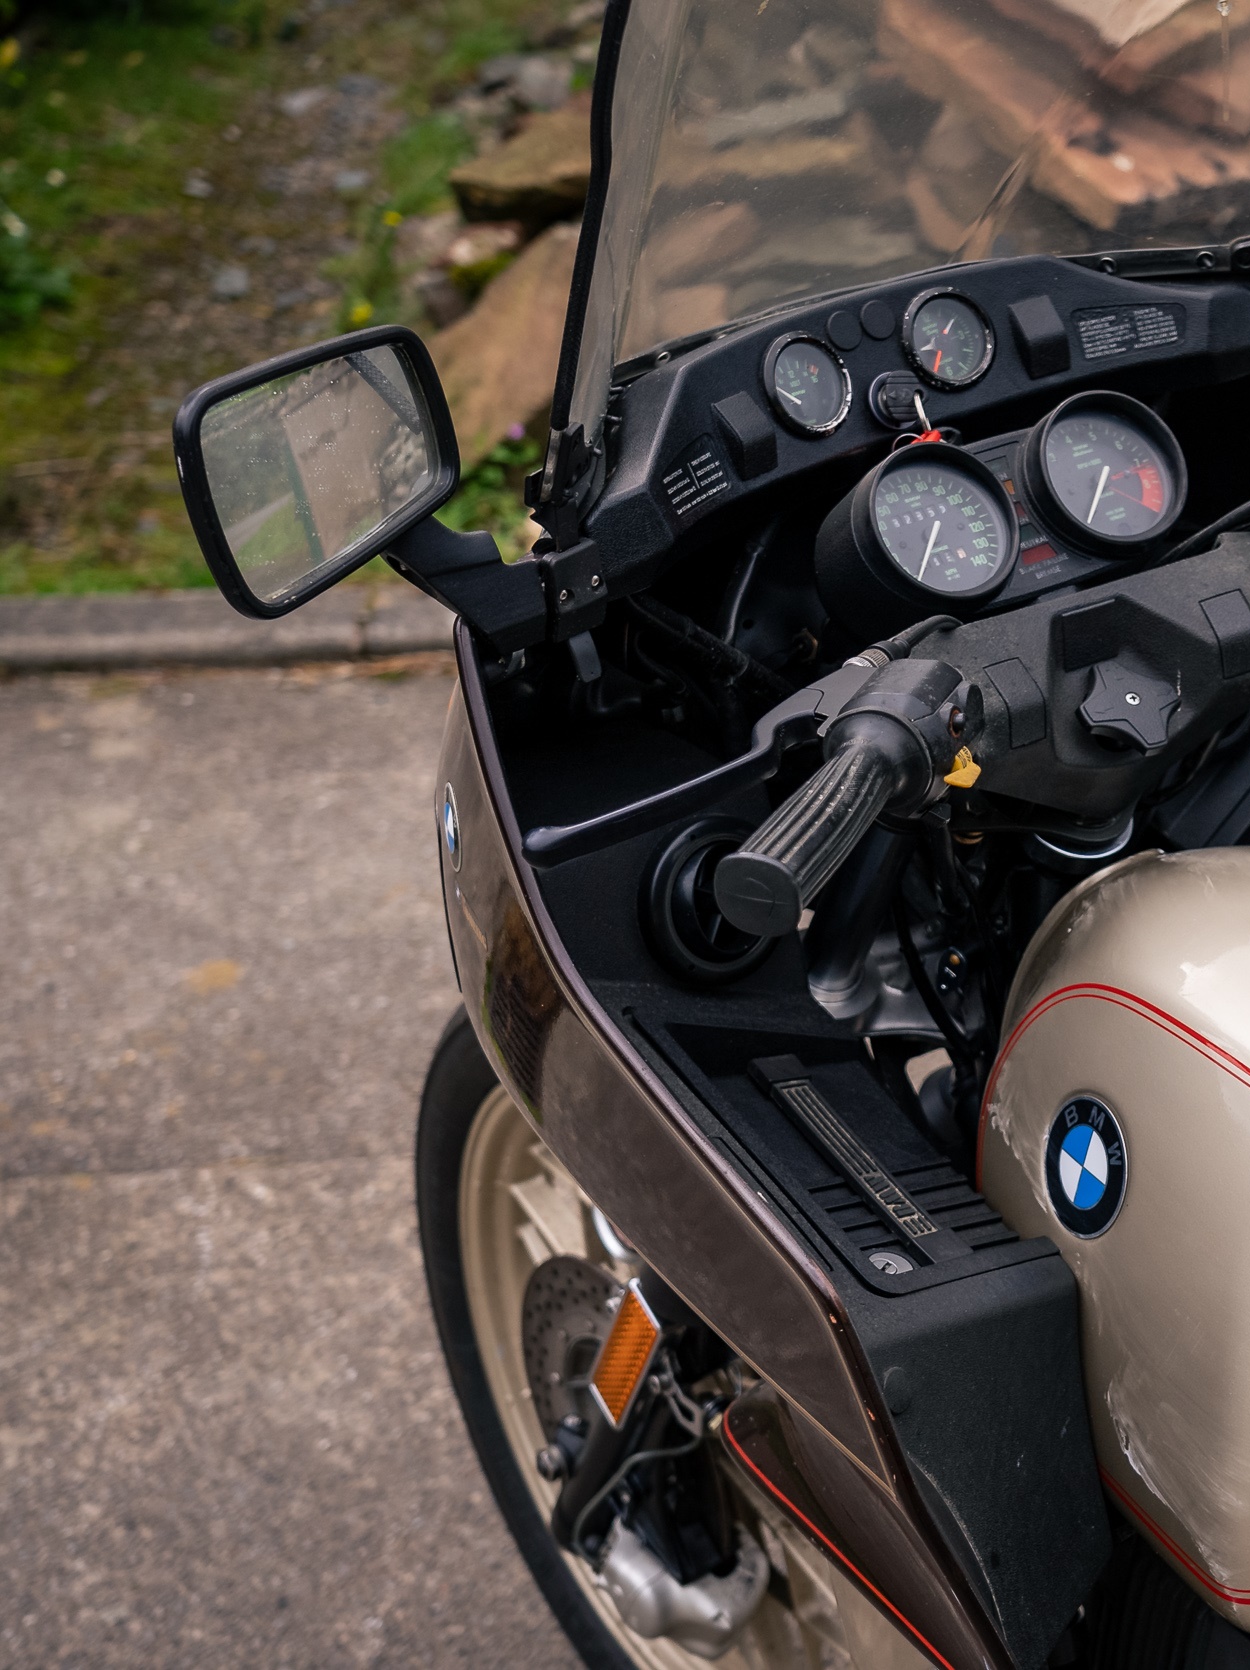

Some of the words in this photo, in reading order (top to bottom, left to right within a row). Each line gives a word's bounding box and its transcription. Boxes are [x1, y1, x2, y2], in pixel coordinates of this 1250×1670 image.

[1065, 435, 1073, 444] 4
[1088, 431, 1098, 441] 5
[1115, 441, 1124, 450] 6
[1133, 458, 1141, 467] 7
[898, 483, 912, 495] 70
[914, 481, 929, 492] 80
[932, 485, 946, 497] 90
[885, 492, 899, 504] 60
[946, 494, 963, 506] 100
[961, 505, 976, 517] 110
[968, 521, 985, 533] 120
[972, 537, 989, 549] 130
[970, 554, 988, 567] 140
[1064, 1104, 1122, 1166] BMW
